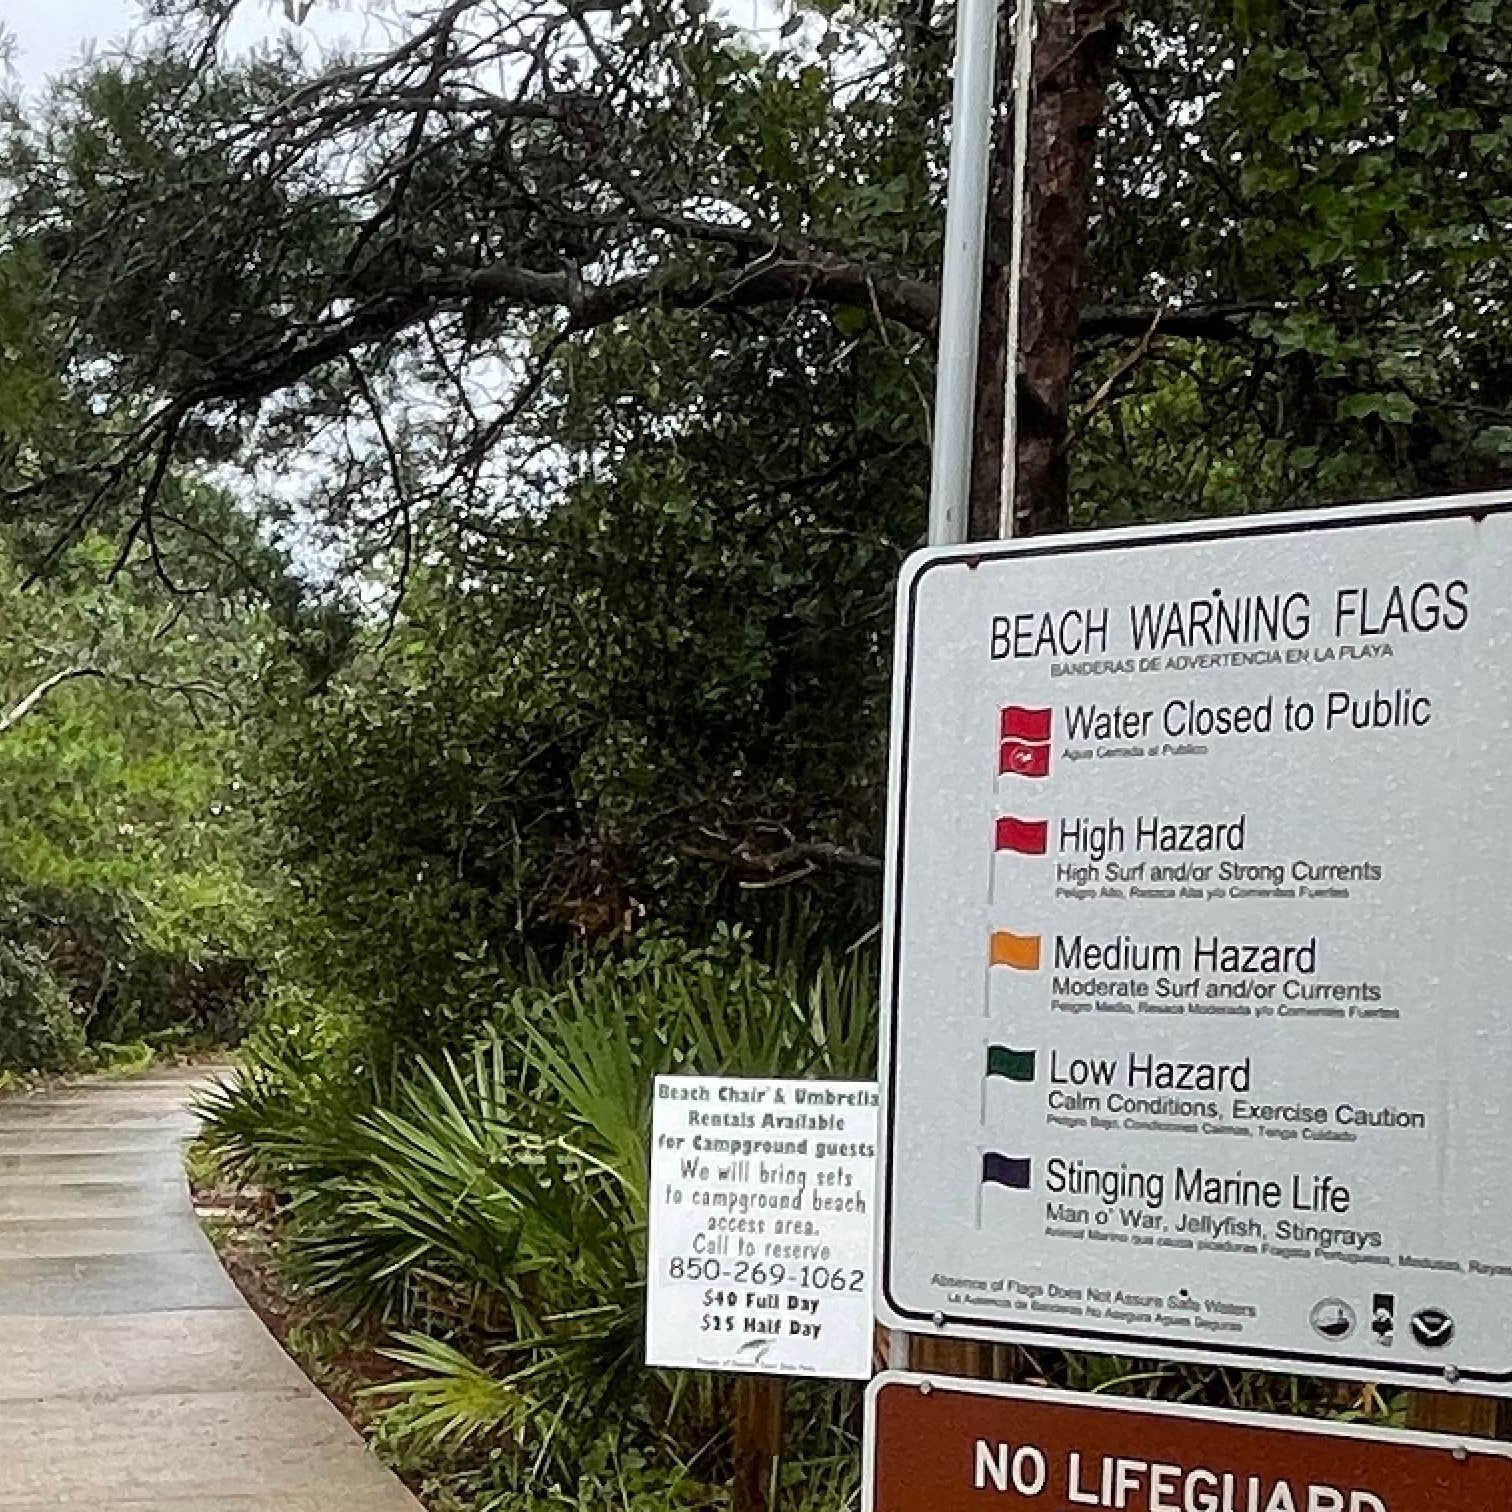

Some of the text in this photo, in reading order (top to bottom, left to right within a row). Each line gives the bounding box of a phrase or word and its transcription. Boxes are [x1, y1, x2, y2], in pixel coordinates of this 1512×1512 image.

[991, 580, 1469, 660] BEACH WARNING FLAGS
[1050, 644, 1393, 677] BANDERAS DE ADVERTENCIA EN LA PLAYA
[1065, 689, 1432, 740] Water Closed to Public
[1060, 814, 1245, 859] High Hazard
[1056, 860, 1382, 885] High Surf and/or Strong Currents
[1054, 935, 1317, 973] Medium Hazard
[1052, 977, 1382, 1001] Moderate Surf and/or Currents
[1049, 1050, 1251, 1092] Low Hazard
[659, 1083, 710, 1102] Beach
[773, 1088, 786, 1104] &
[1048, 1090, 1426, 1129] Calm Conditions, Exercise Caution
[688, 1110, 845, 1131] Rentals Available
[659, 1133, 876, 1159] for Campground guests
[680, 1156, 853, 1189] We will bring sets
[1046, 1158, 1350, 1213] Stinging Marine Life
[665, 1184, 866, 1214] to campground beach
[707, 1217, 820, 1236] access area.
[1046, 1203, 1088, 1225] Man
[1118, 1208, 1169, 1232] War,
[1175, 1213, 1267, 1240] Jellyfish,
[1275, 1220, 1382, 1250] Stingrays
[692, 1232, 831, 1261] Call to reserve
[669, 1256, 865, 1292] 850-269-1062
[991, 1280, 1004, 1291] of
[1007, 1280, 1043, 1298] Flags
[1048, 1284, 1082, 1299] Does
[1087, 1288, 1111, 1301] Not
[704, 1288, 820, 1314] $40 Full Day
[744, 1317, 782, 1335] Half
[788, 1320, 822, 1340] Day
[975, 1440, 1045, 1495] NO
